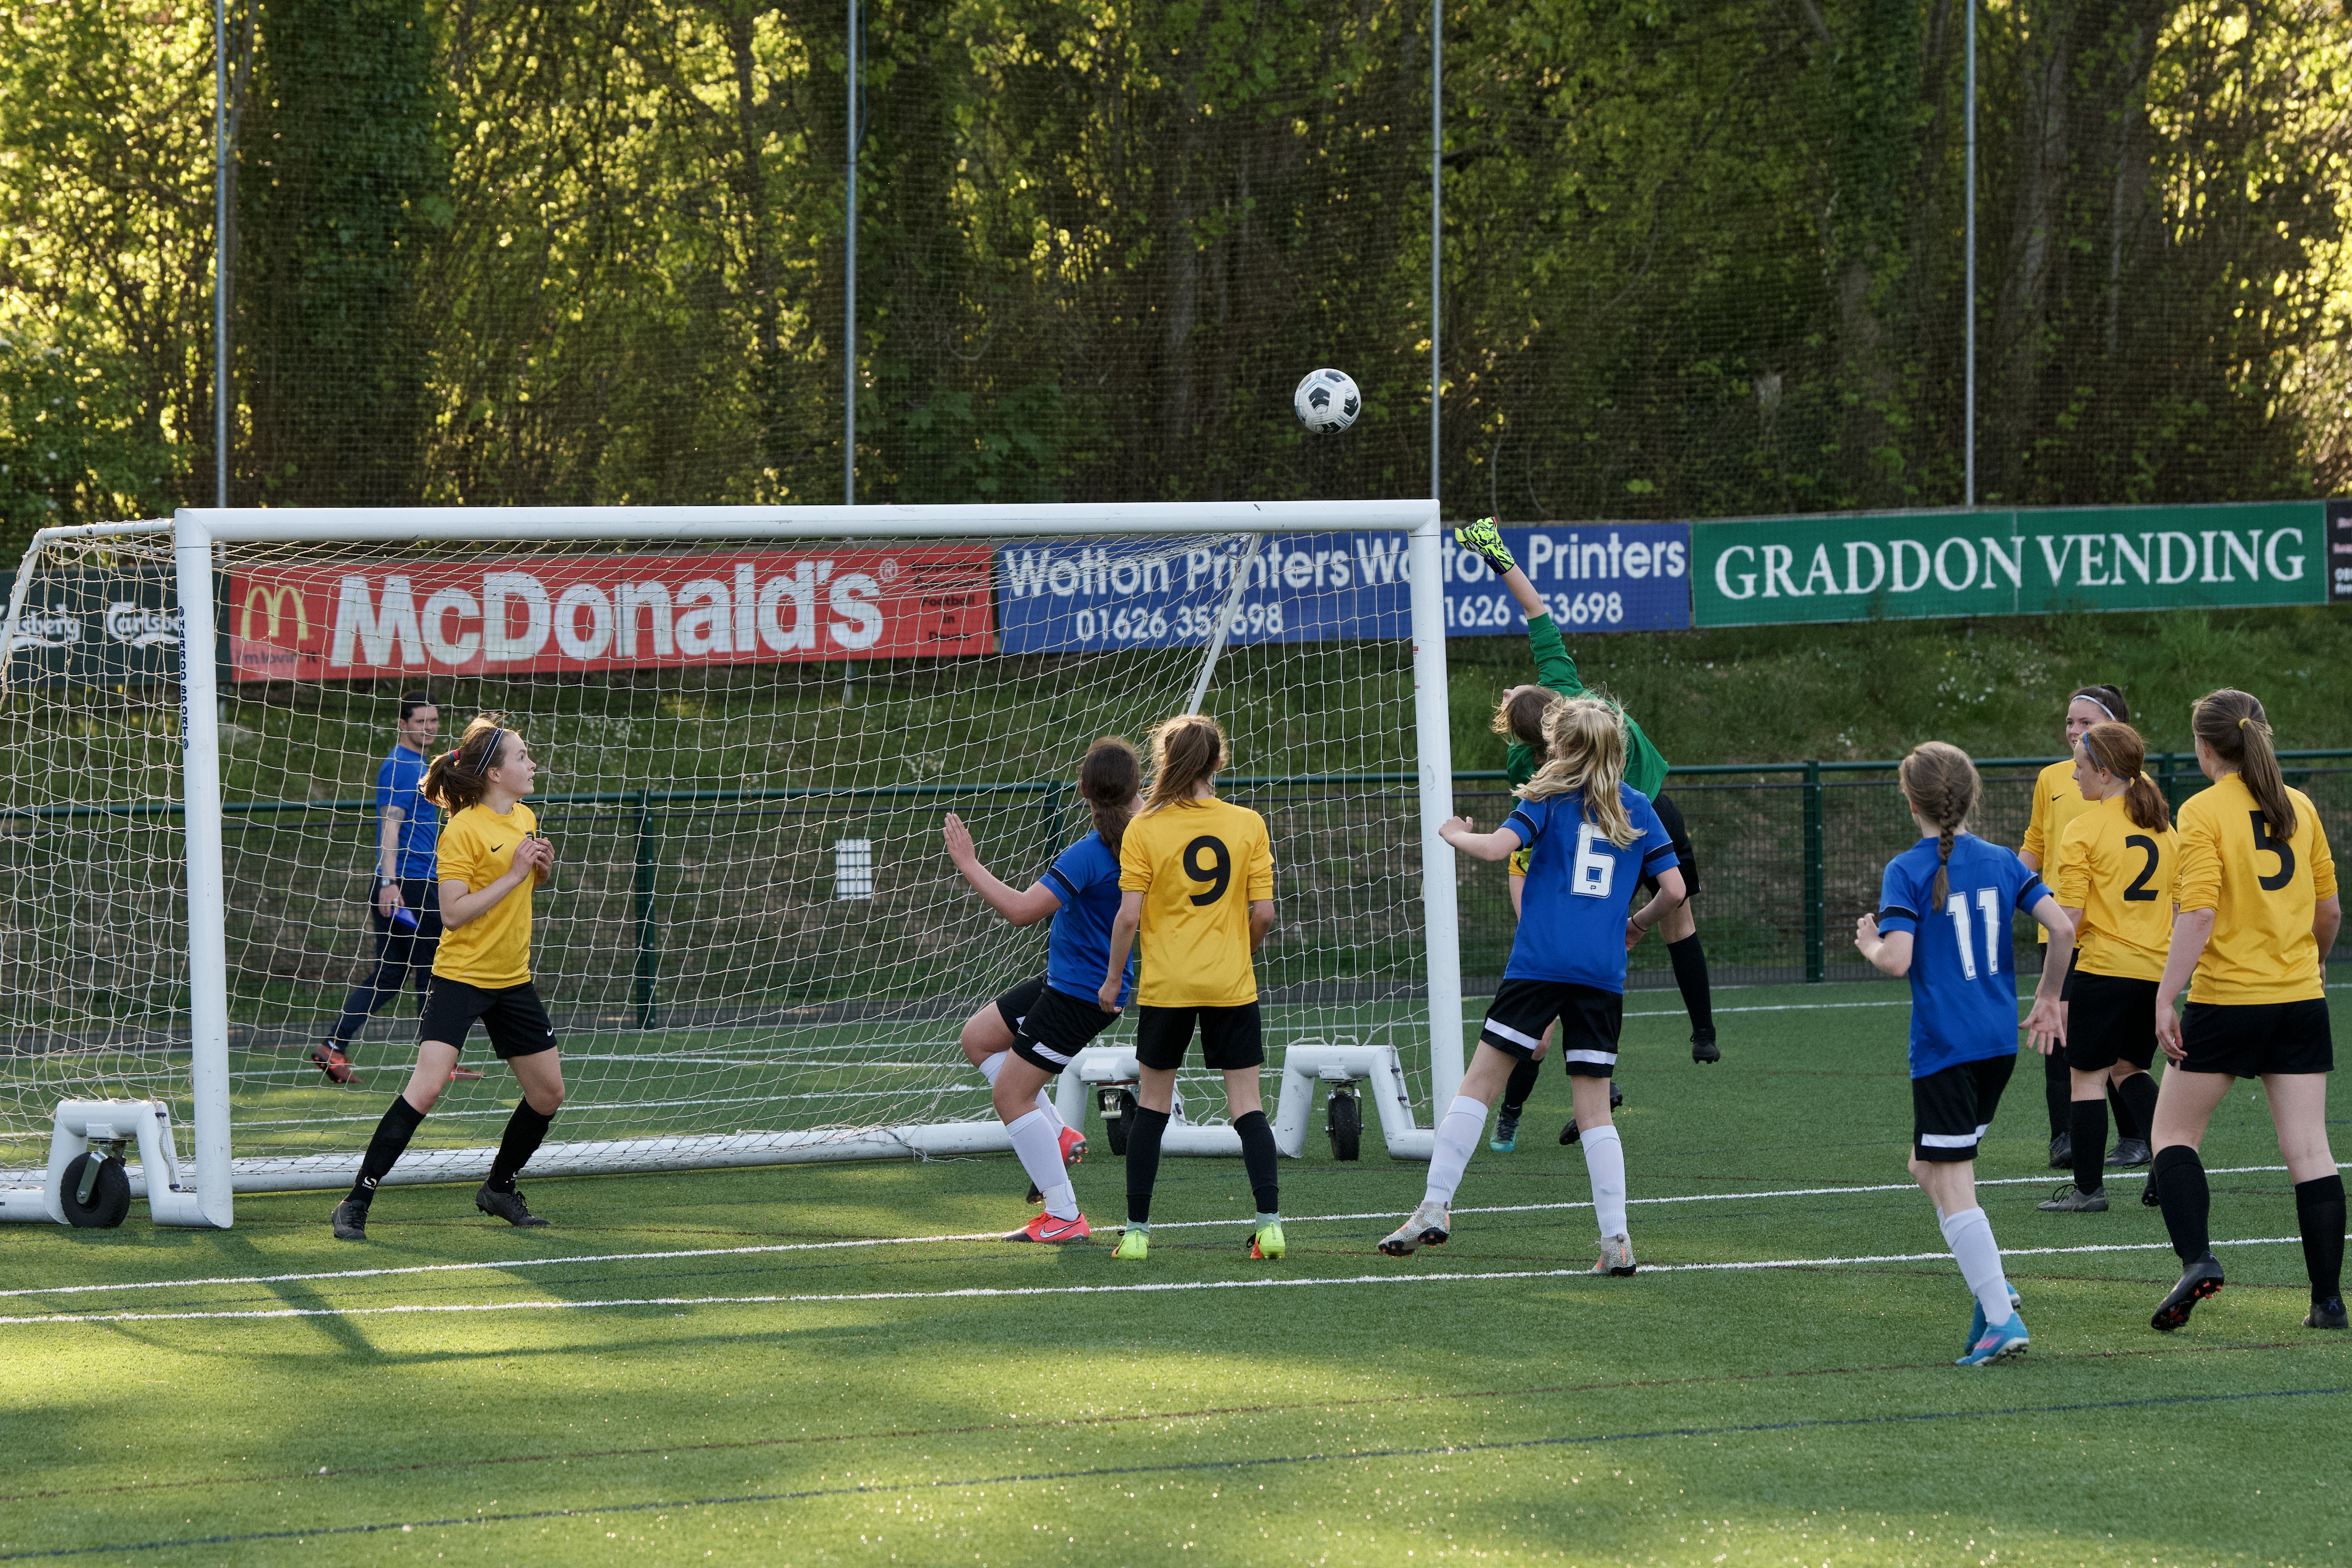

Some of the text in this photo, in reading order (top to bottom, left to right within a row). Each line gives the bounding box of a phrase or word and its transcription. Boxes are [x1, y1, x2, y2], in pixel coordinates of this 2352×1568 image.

[1004, 542, 1350, 597] Wotton Printers
[1356, 531, 1686, 585] Wto Printers
[1715, 527, 2306, 599] GRADDON VENDING
[0, 603, 81, 642] lsberg
[921, 594, 975, 606] Football
[1076, 607, 1168, 642] 01626
[1444, 594, 1511, 627] 1626
[178, 620, 189, 736] HARROD SPORT
[1183, 835, 1231, 906] 9
[1571, 822, 1616, 898] 6
[2123, 835, 2159, 901] 2
[2249, 811, 2295, 891] 5
[1946, 887, 2000, 981] 11
